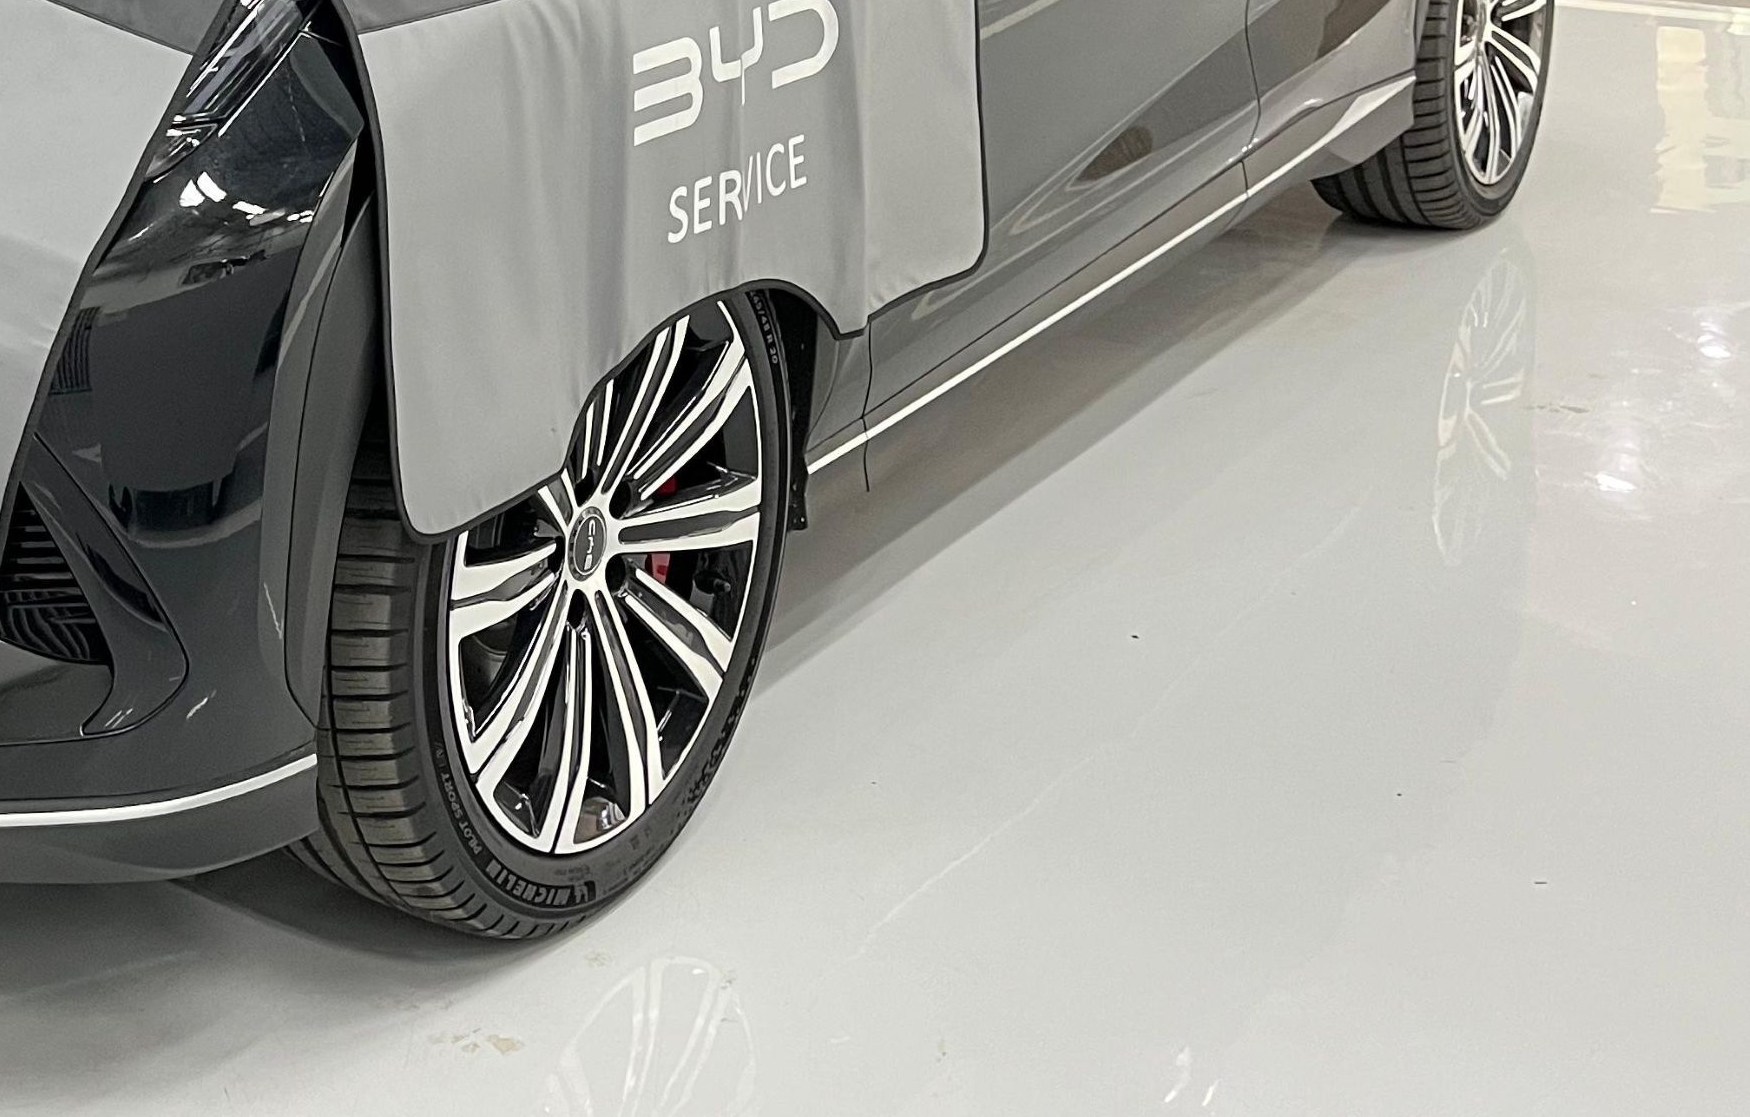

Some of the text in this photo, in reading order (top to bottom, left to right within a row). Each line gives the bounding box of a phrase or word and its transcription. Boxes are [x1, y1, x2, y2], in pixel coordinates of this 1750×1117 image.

[667, 134, 808, 244] SERVICE
[441, 772, 464, 819] SPORT
[459, 821, 483, 855] PILOT
[486, 859, 571, 906] MICHELIN
